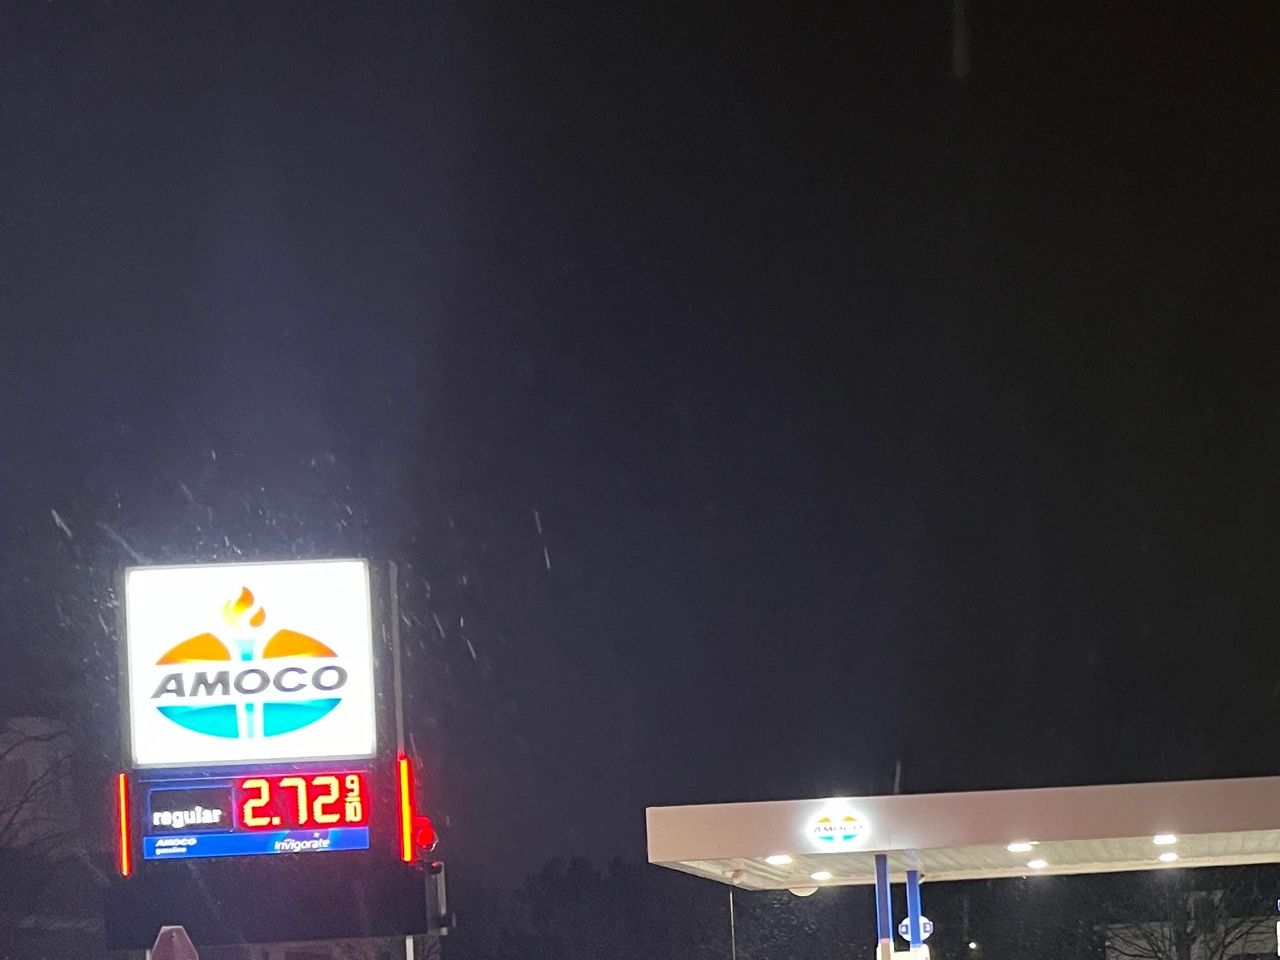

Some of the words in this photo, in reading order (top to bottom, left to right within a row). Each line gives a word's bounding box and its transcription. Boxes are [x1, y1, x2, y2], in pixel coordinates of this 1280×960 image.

[151, 665, 348, 699] AMOCO
[242, 775, 340, 827] 2.72
[152, 805, 223, 829] regular
[813, 825, 863, 833] AMOO
